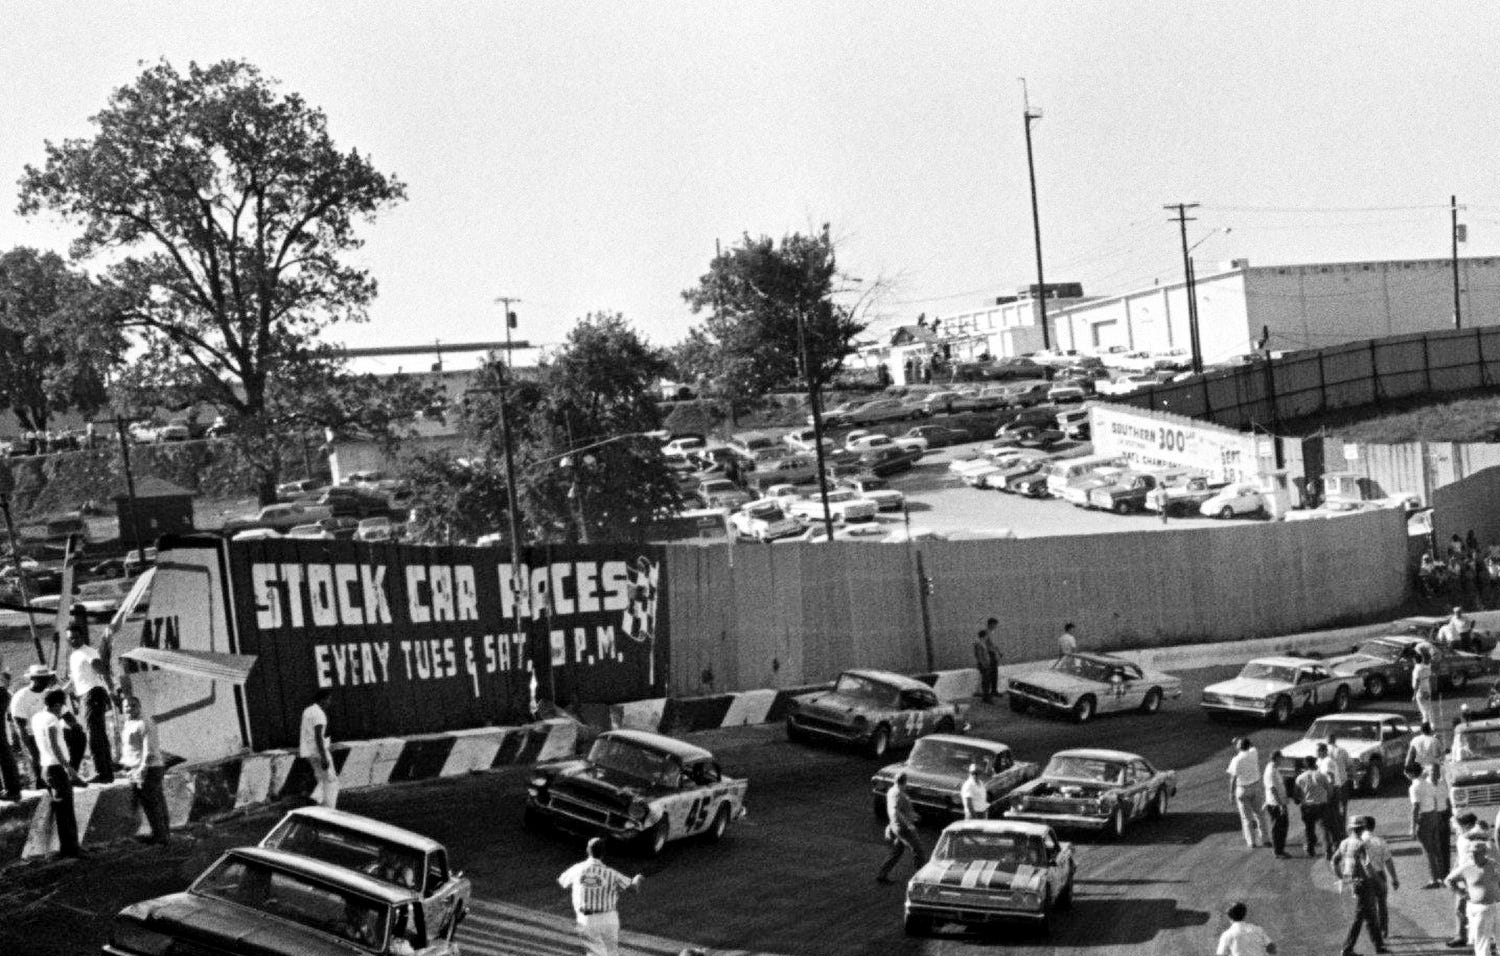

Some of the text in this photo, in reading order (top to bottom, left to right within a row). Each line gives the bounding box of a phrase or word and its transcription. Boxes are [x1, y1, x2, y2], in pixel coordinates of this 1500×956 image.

[1111, 422, 1156, 443] SOUTHERN
[1159, 427, 1186, 453] 300
[252, 560, 629, 629] STOCK CAR RACES
[314, 641, 390, 688] EVERY
[401, 637, 457, 680] TUES
[685, 796, 711, 833] 45
